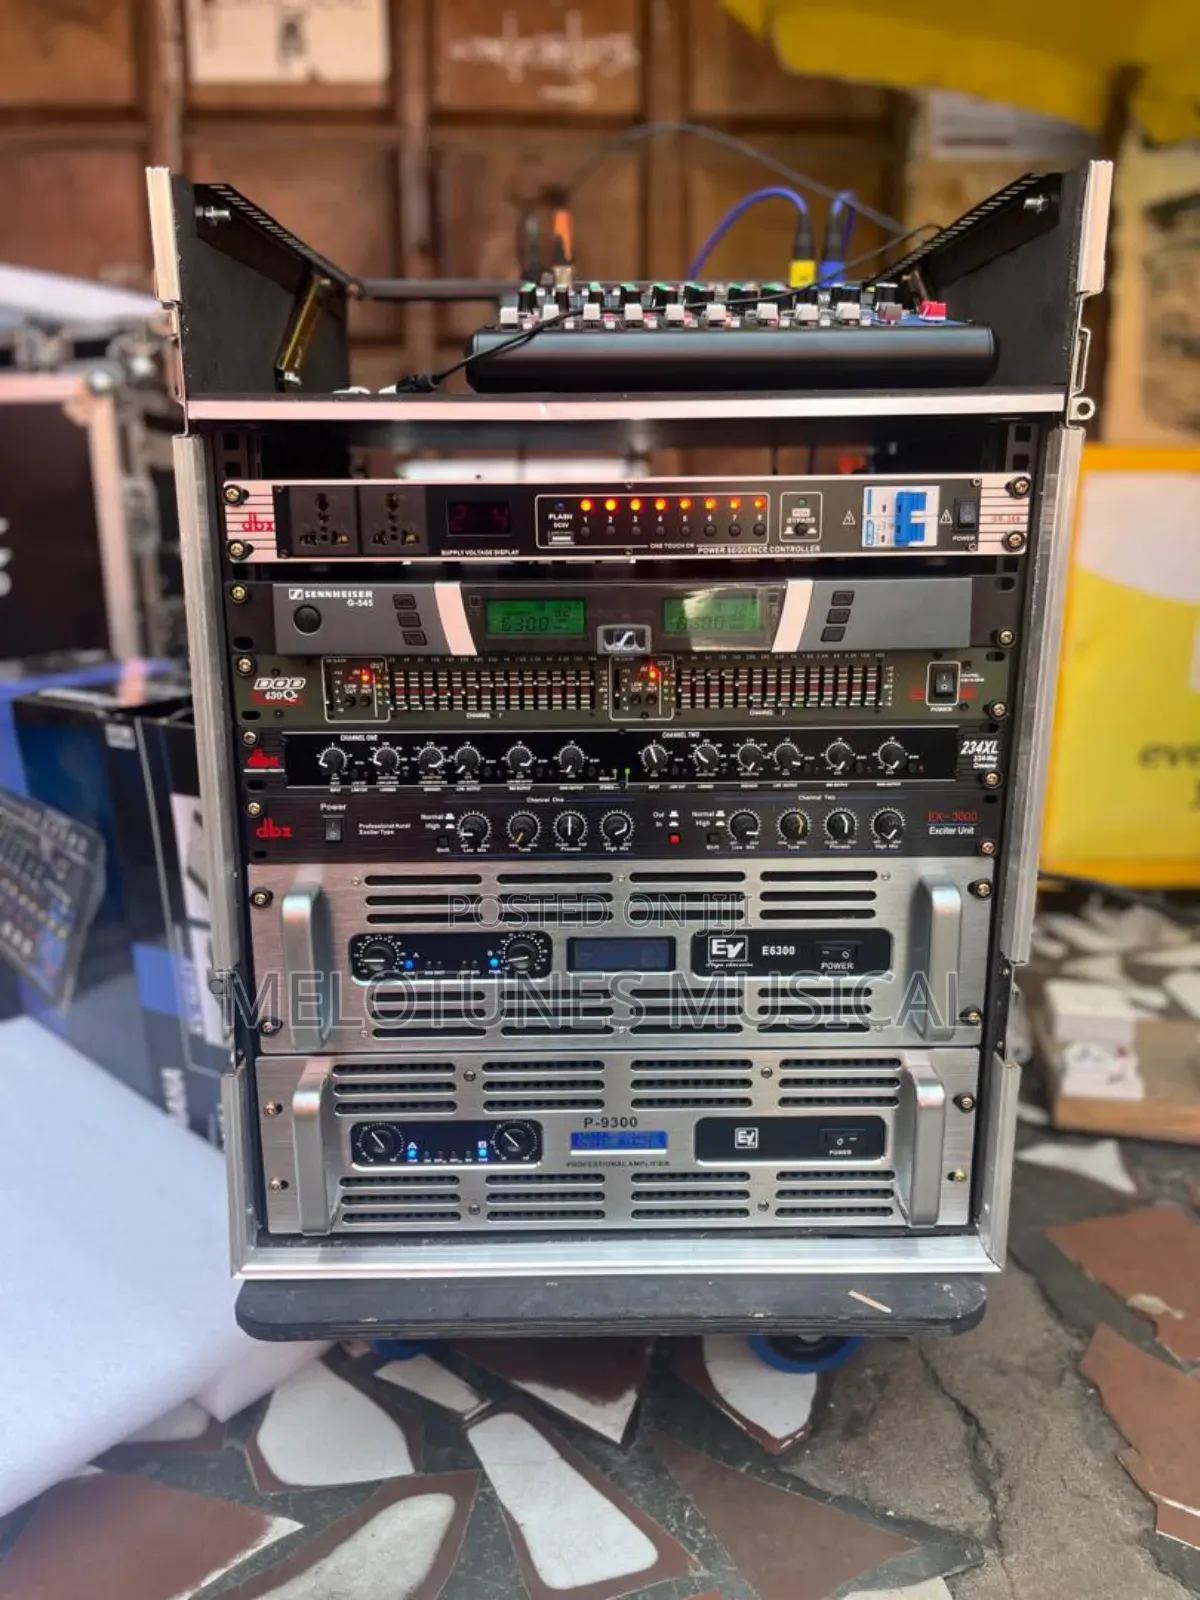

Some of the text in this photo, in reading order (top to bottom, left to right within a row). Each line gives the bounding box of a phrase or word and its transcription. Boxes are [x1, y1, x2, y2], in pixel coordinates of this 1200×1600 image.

[242, 512, 274, 532] dbx
[698, 545, 821, 554] POWER SEQUENCE CONTROLLER
[304, 590, 373, 599] SENNHEISER
[347, 599, 374, 607] G-545
[253, 677, 306, 690] DOD
[340, 734, 364, 742] CHANNEL
[960, 739, 999, 755] 234XL
[320, 803, 347, 811] Power
[256, 817, 292, 838] dbx
[929, 826, 975, 835] Exciter Unit
[762, 945, 796, 956] E6300
[820, 962, 854, 970] POWER
[584, 1116, 638, 1129] P-9300
